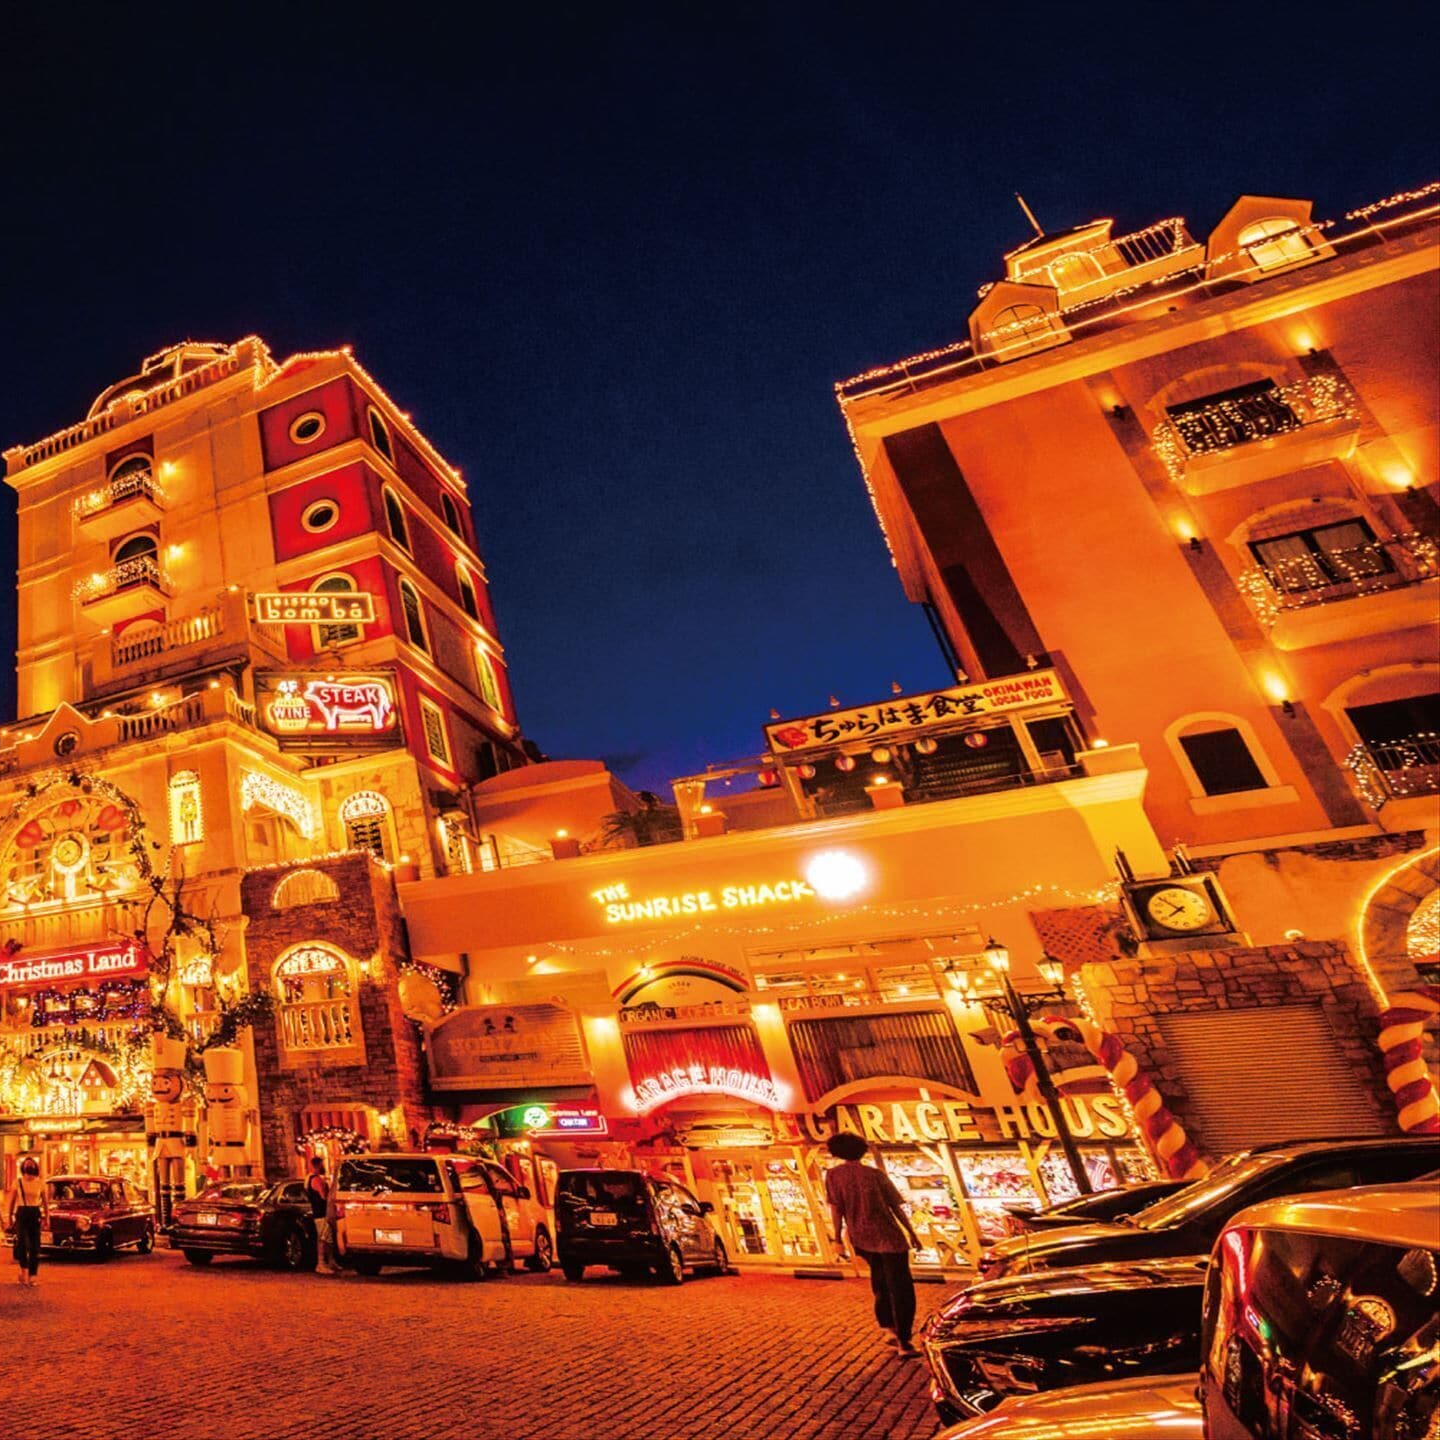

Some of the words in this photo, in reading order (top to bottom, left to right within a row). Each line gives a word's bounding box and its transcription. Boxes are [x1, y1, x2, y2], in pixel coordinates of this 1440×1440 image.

[267, 598, 320, 619] bom
[320, 688, 378, 703] STEAK
[982, 676, 1053, 698] OKINAWAN
[990, 694, 1024, 707] LOCAL
[1024, 688, 1054, 701] FOOD
[273, 706, 312, 719] WINE
[810, 694, 986, 742] ちゅらはま食堂
[592, 884, 630, 904] THE
[606, 891, 717, 923] SUNRISE
[722, 880, 816, 907] SHACK
[87, 947, 136, 973] Land
[806, 1102, 981, 1143] GARAGE
